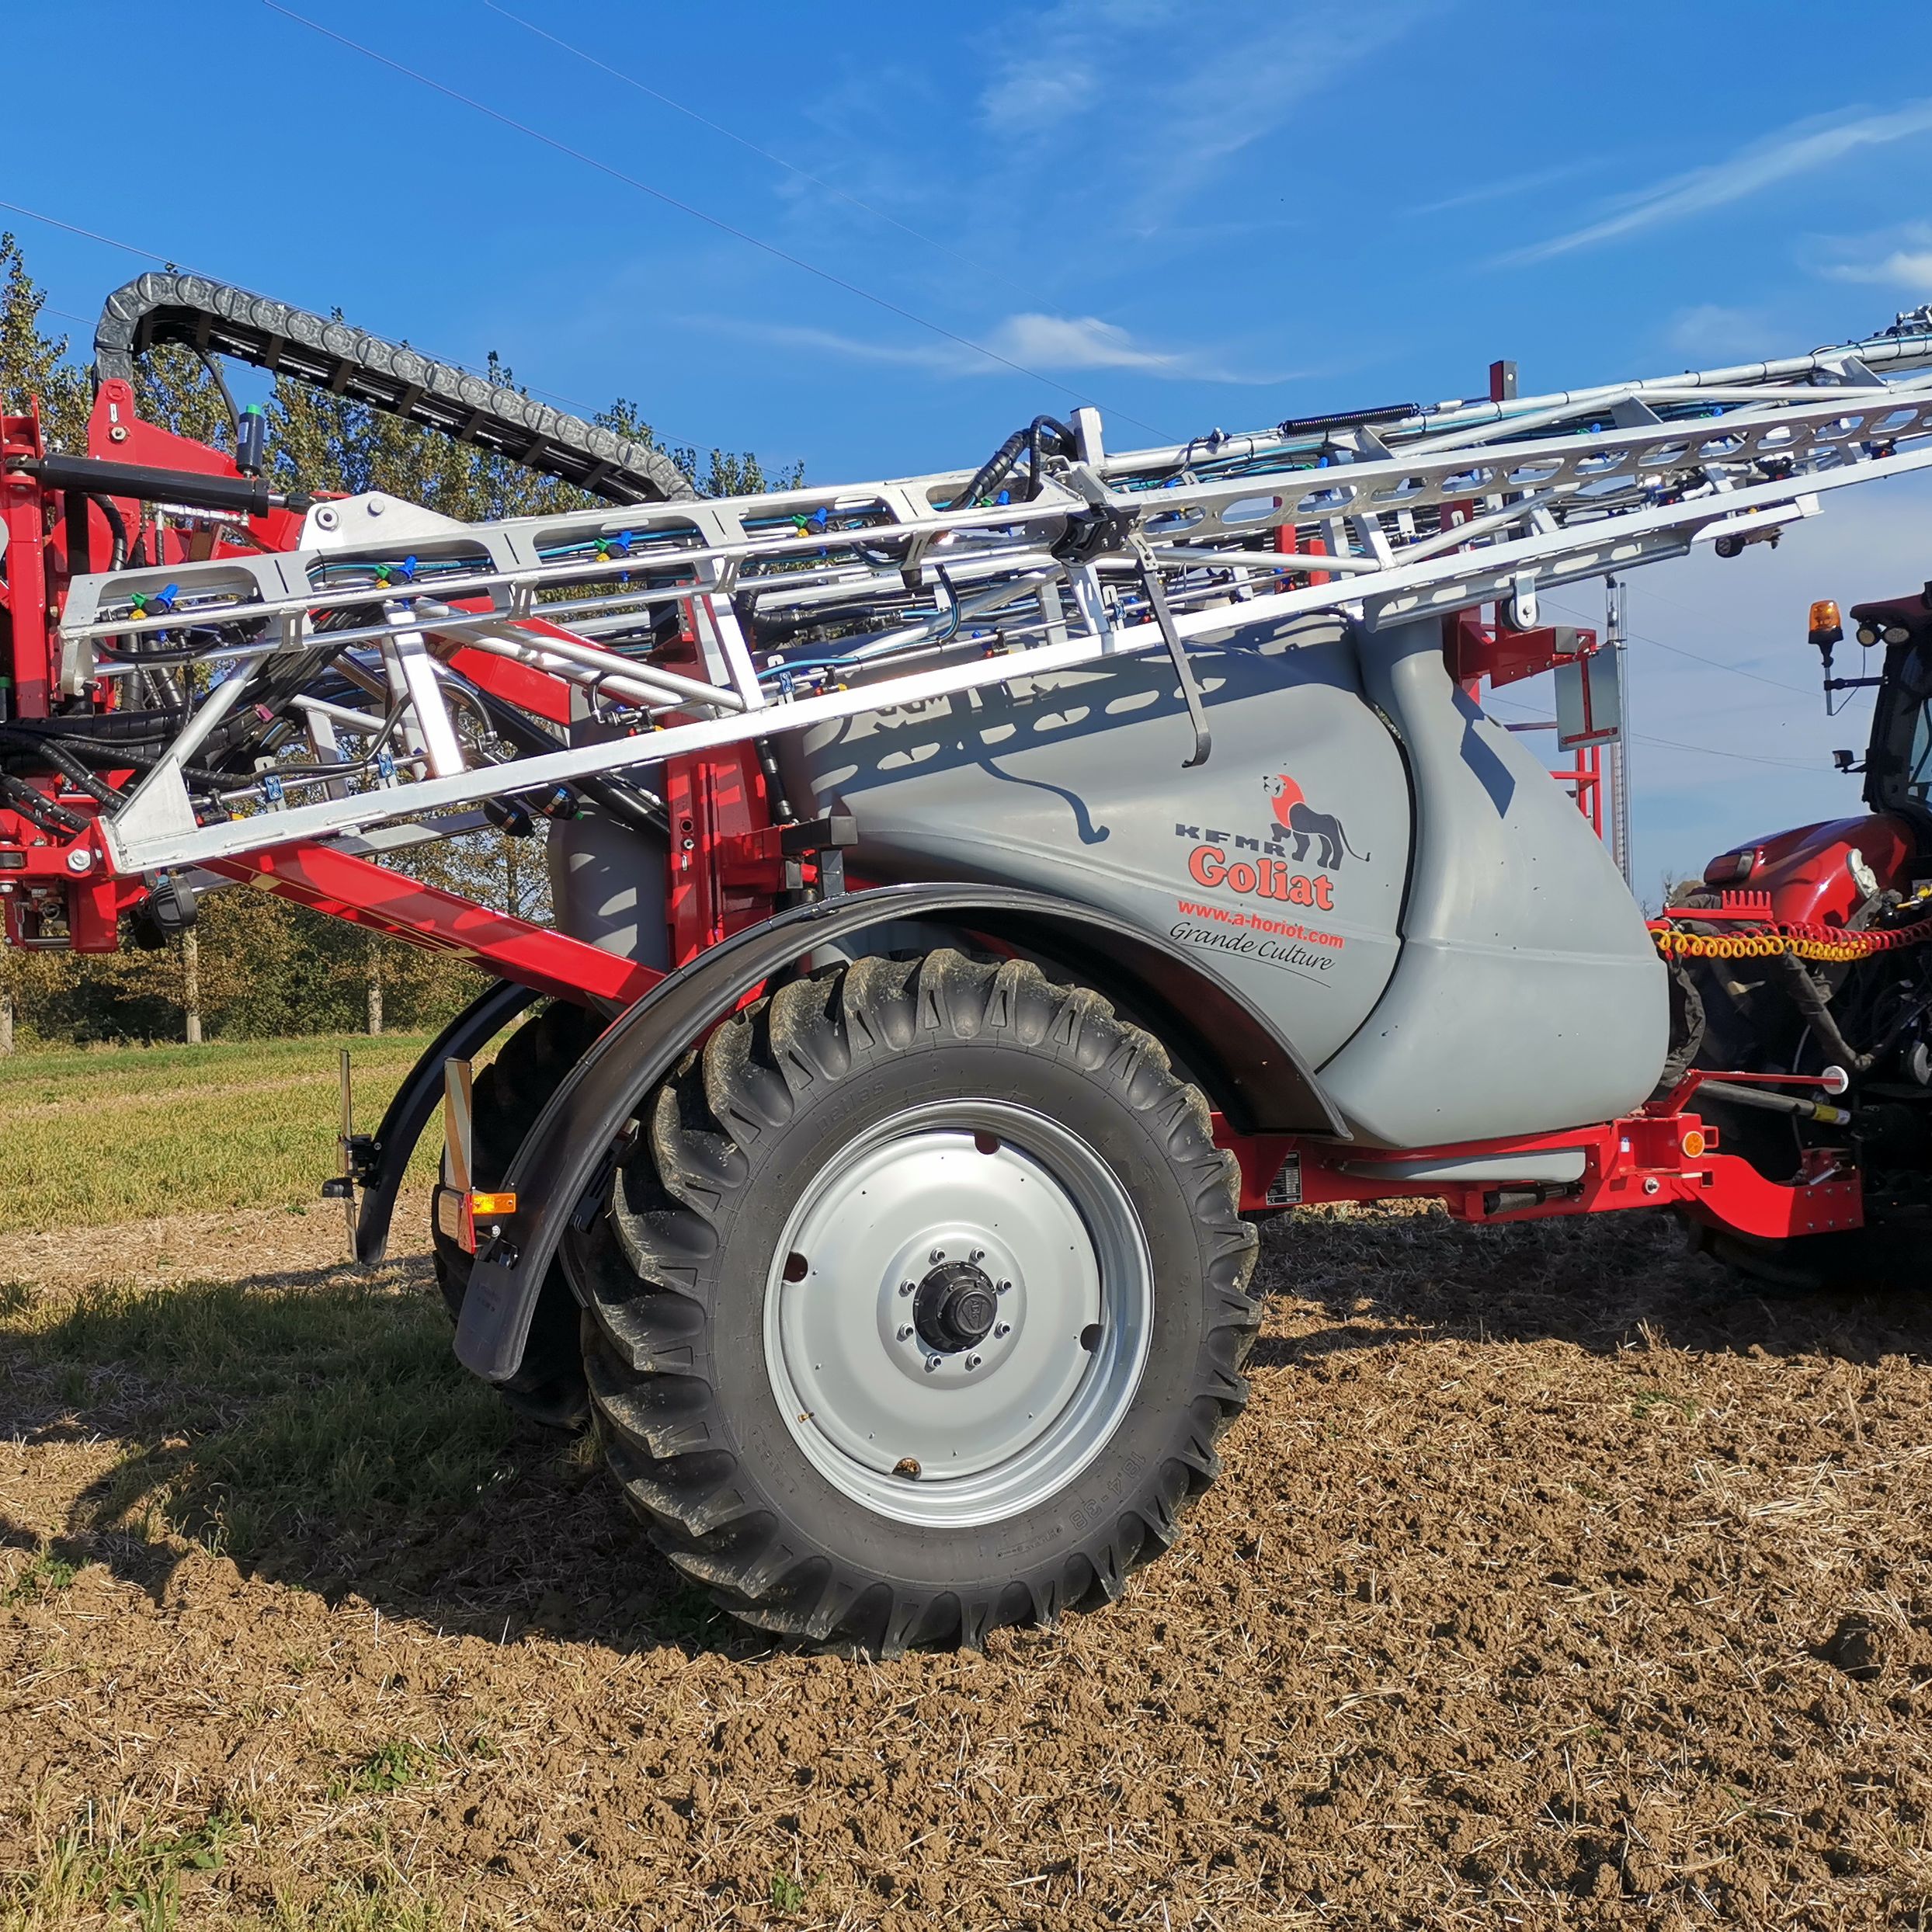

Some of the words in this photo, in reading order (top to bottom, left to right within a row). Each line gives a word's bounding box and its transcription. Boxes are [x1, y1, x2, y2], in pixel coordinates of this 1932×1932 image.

[1176, 823, 1286, 858] KFMR
[1188, 845, 1335, 911] Goliat
[1169, 922, 1257, 953] Grande
[1258, 941, 1335, 970] Culture
[1177, 900, 1345, 949] www.a-horiot.com
[1069, 1451, 1146, 1531] 18.4-38
